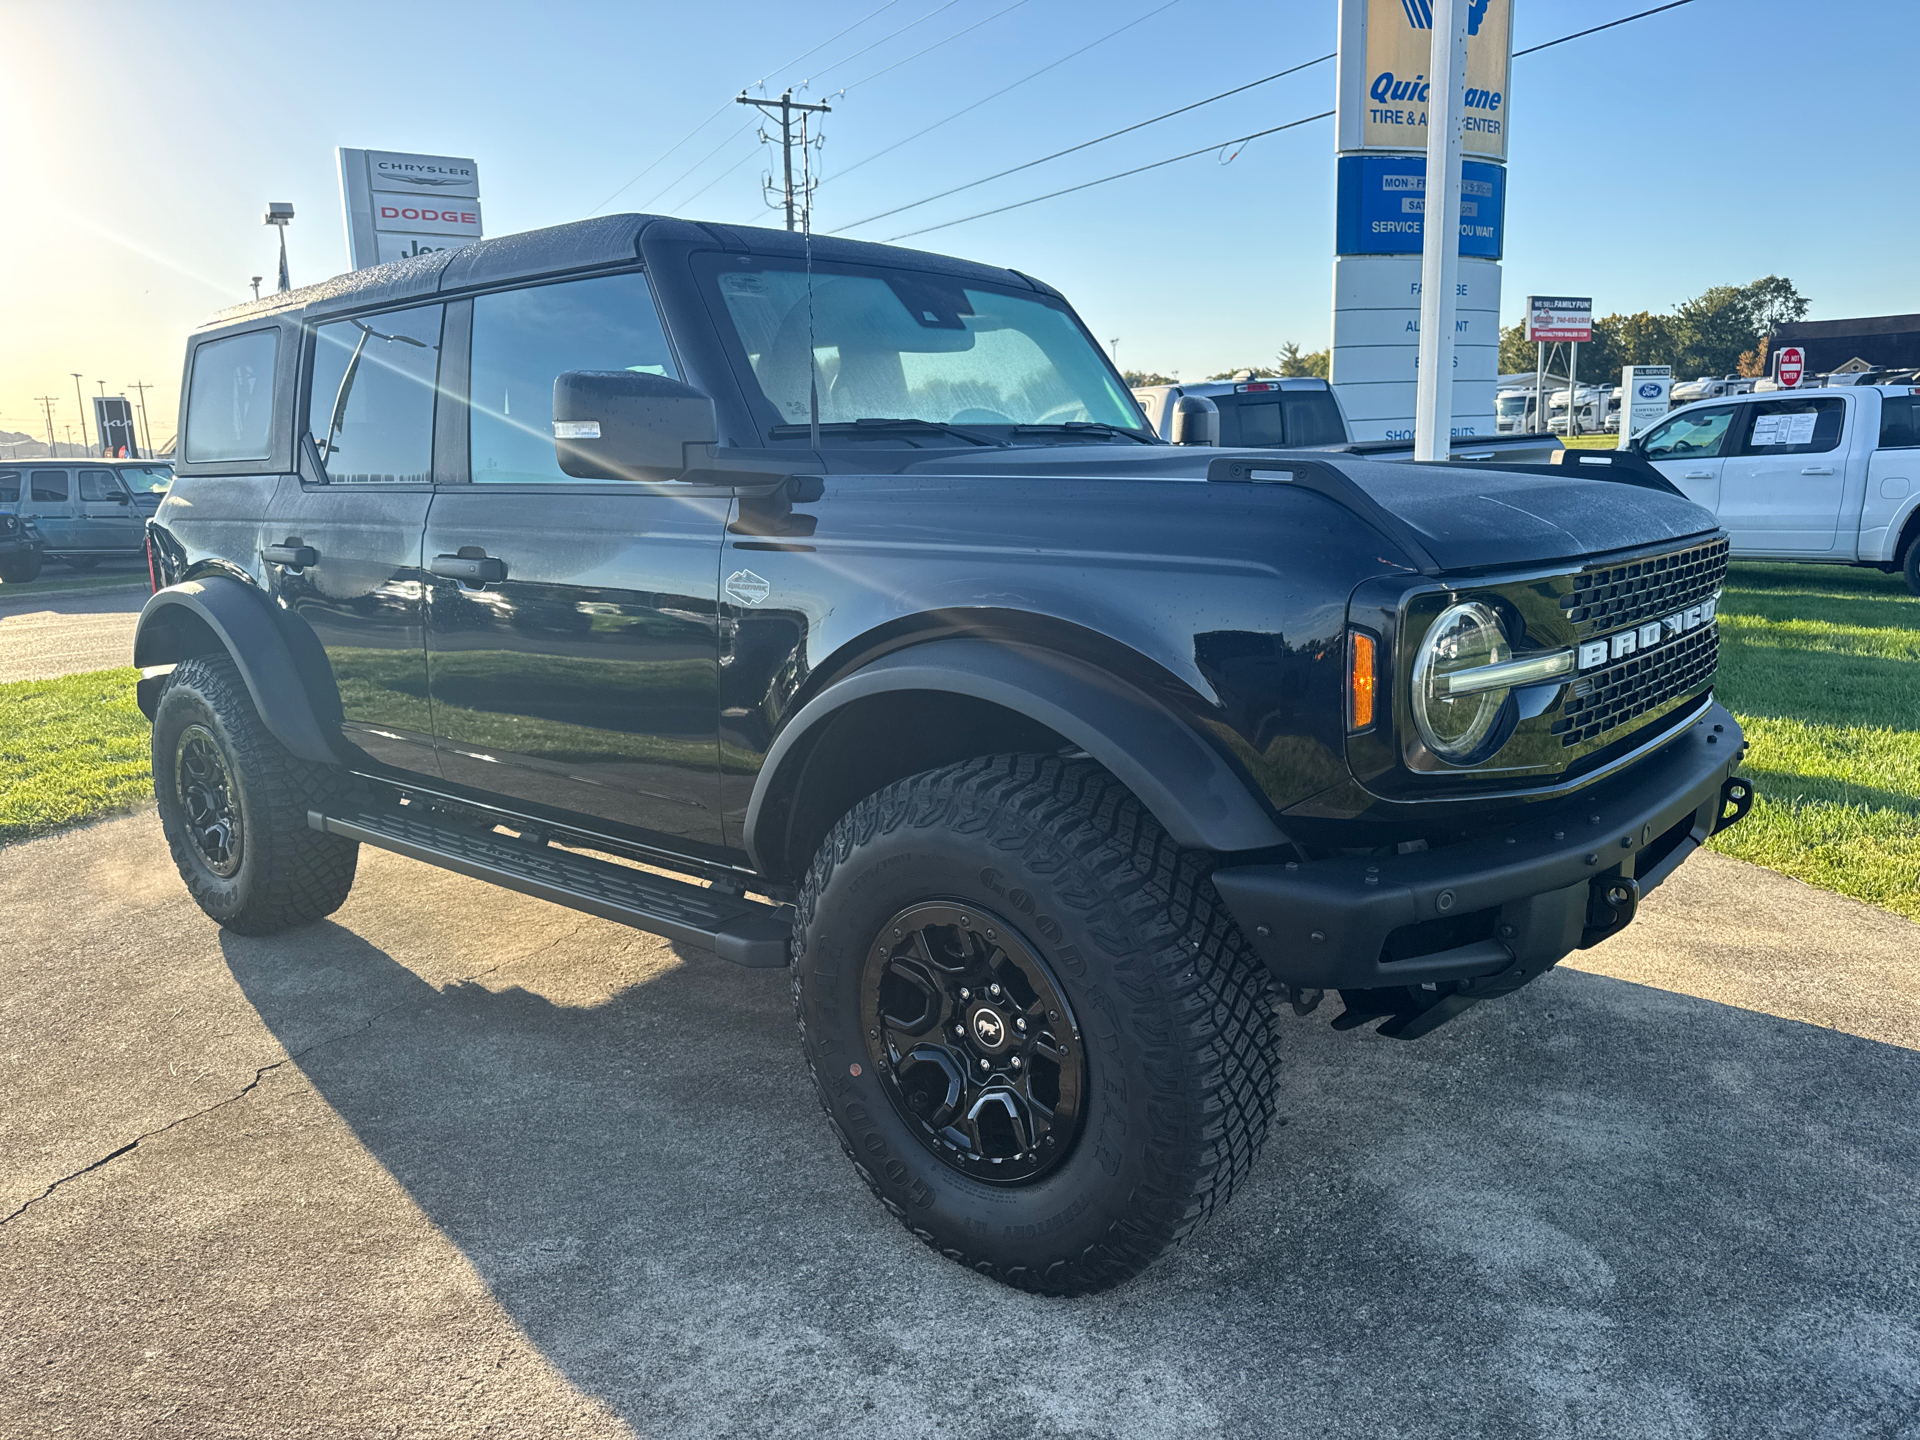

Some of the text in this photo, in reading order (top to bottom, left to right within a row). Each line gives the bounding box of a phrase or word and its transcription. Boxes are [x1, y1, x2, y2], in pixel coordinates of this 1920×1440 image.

[1370, 72, 1501, 111] Quic ane
[1370, 109, 1404, 125] TIRE
[1406, 111, 1416, 126] &
[1463, 116, 1501, 135] ENTER
[378, 162, 470, 176] CHRYSLER
[1384, 178, 1409, 188] MON
[381, 206, 477, 224] DODGE
[1371, 220, 1420, 233] SERVICE
[1475, 225, 1494, 238] WAIT
[1554, 300, 1576, 309] FAMILY
[1783, 372, 1797, 380] ENTER
[1642, 385, 1658, 396] Ford
[728, 582, 768, 592] WILDTRAK
[1578, 598, 1716, 670] BRONCO
